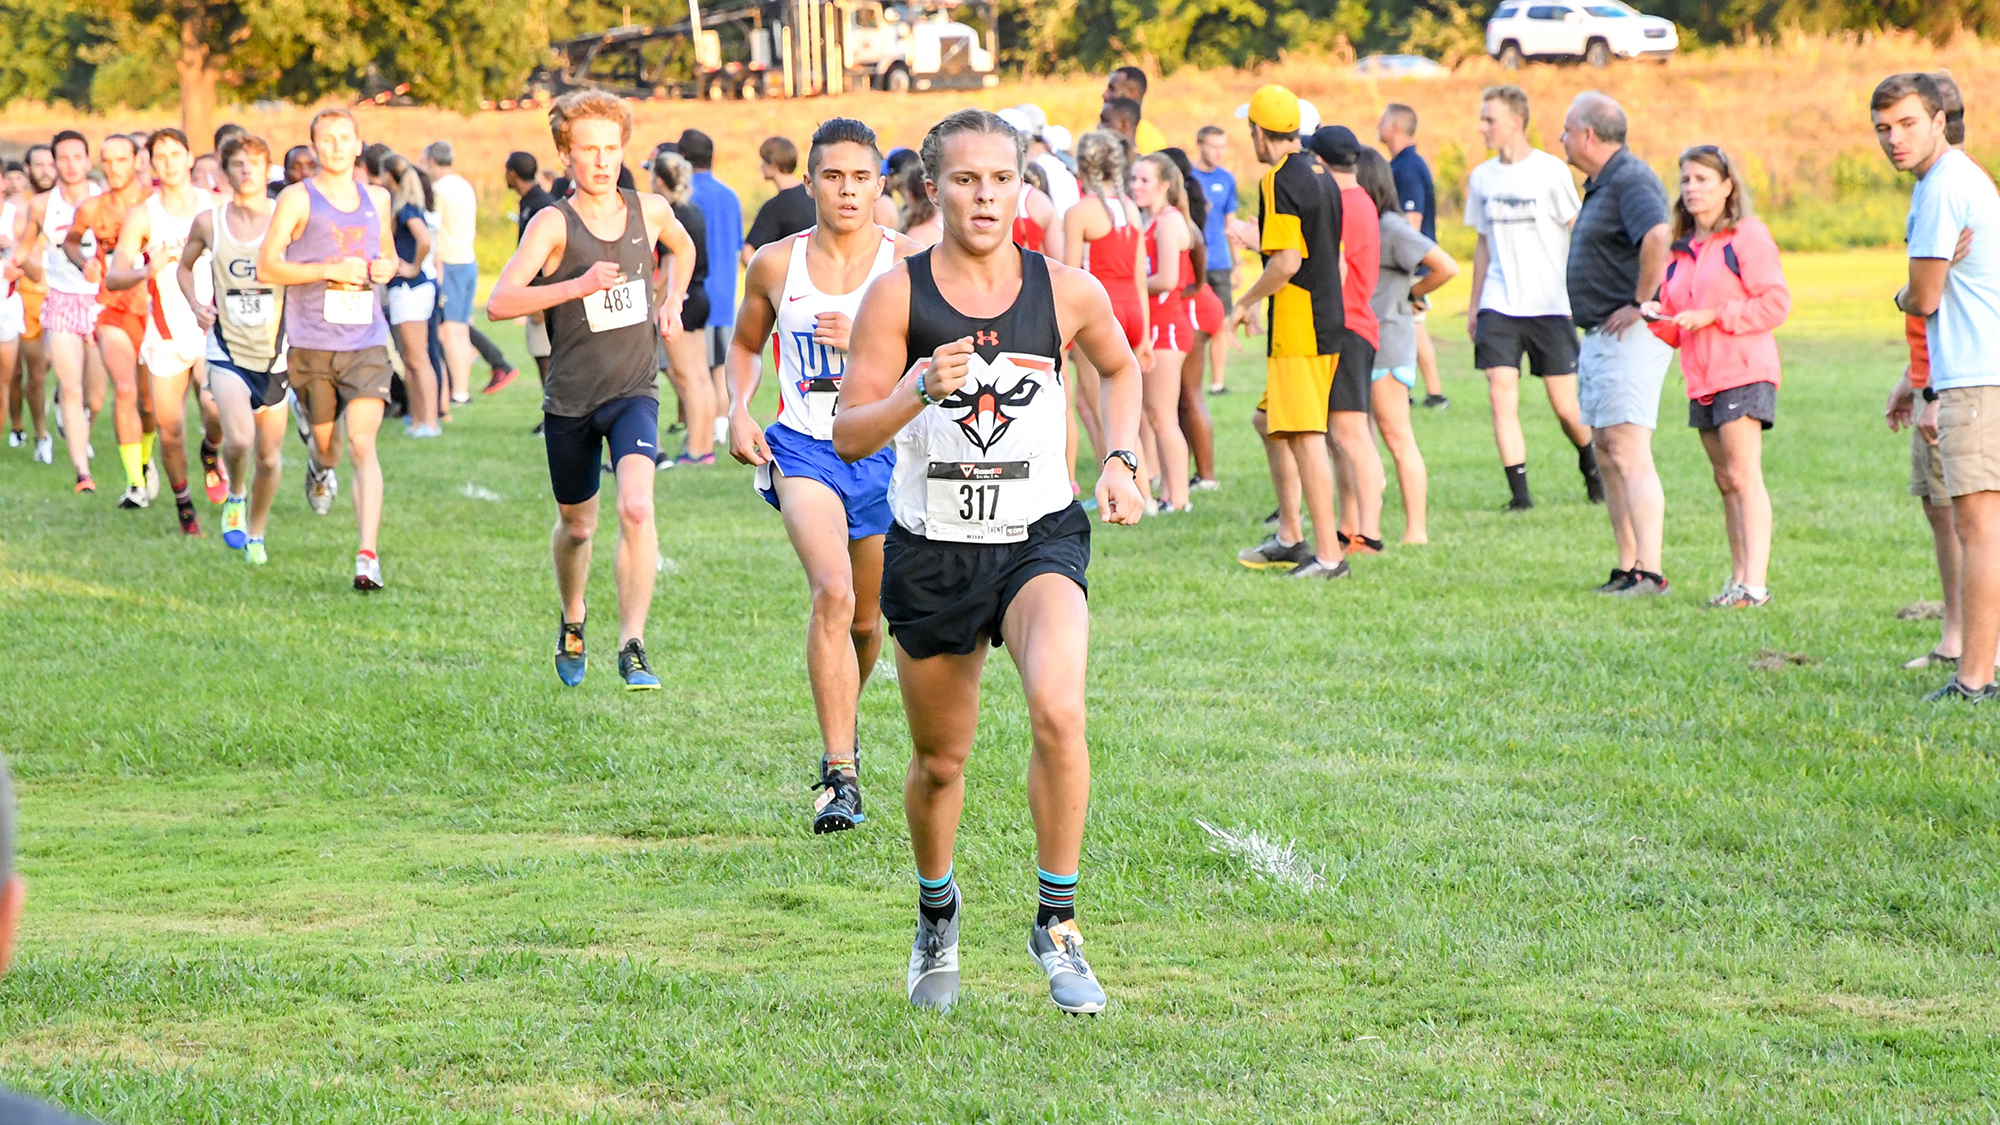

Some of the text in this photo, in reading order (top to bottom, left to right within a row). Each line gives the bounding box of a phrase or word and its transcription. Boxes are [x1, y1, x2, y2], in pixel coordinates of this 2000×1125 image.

[240, 299, 261, 314] 358
[604, 287, 632, 313] 483
[959, 484, 1000, 520] 317
